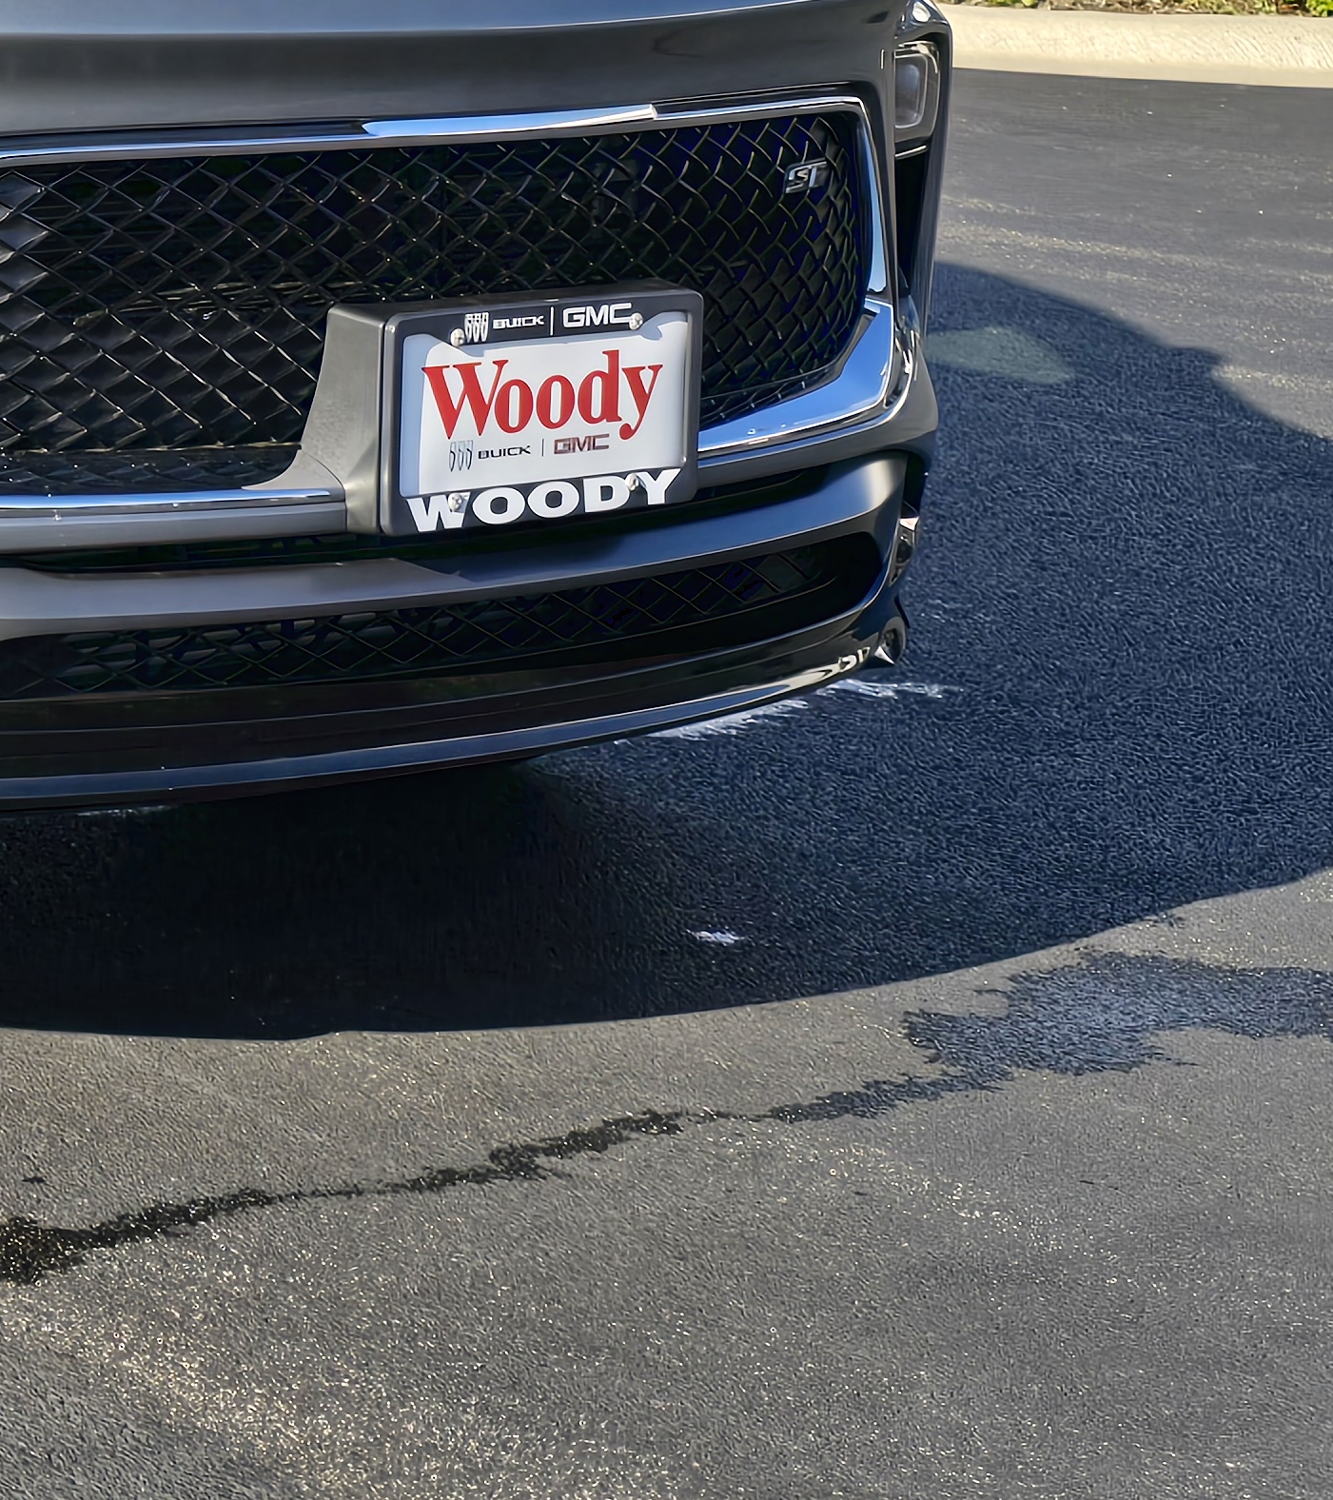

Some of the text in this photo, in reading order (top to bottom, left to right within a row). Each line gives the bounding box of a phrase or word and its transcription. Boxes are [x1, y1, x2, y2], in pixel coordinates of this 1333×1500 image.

[785, 160, 828, 194] ST
[492, 302, 633, 330] BUICK GMC
[421, 349, 664, 441] Woody
[477, 434, 610, 460] BUICK GMC
[405, 467, 682, 533] WOODY
